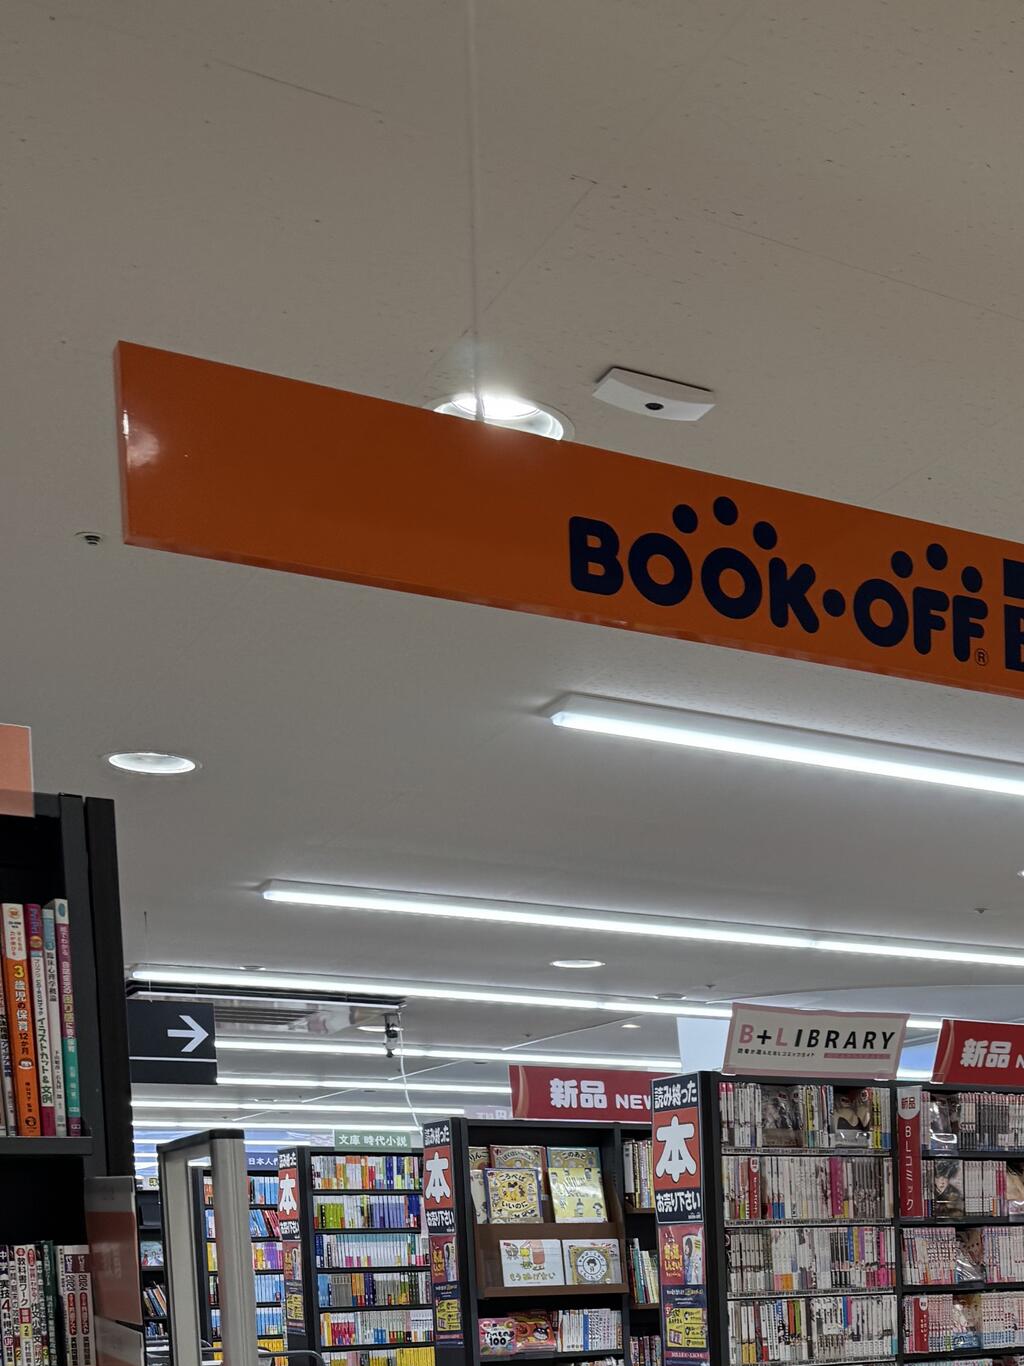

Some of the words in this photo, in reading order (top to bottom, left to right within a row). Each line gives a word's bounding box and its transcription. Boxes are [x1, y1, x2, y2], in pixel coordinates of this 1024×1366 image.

[960, 1038, 1012, 1068] 新品
[550, 1078, 608, 1109] 新品
[901, 1097, 916, 1110] 新品
[339, 1135, 360, 1146] 文庫
[364, 1135, 408, 1147] 時代小説
[904, 1125, 914, 1211] BLコミック
